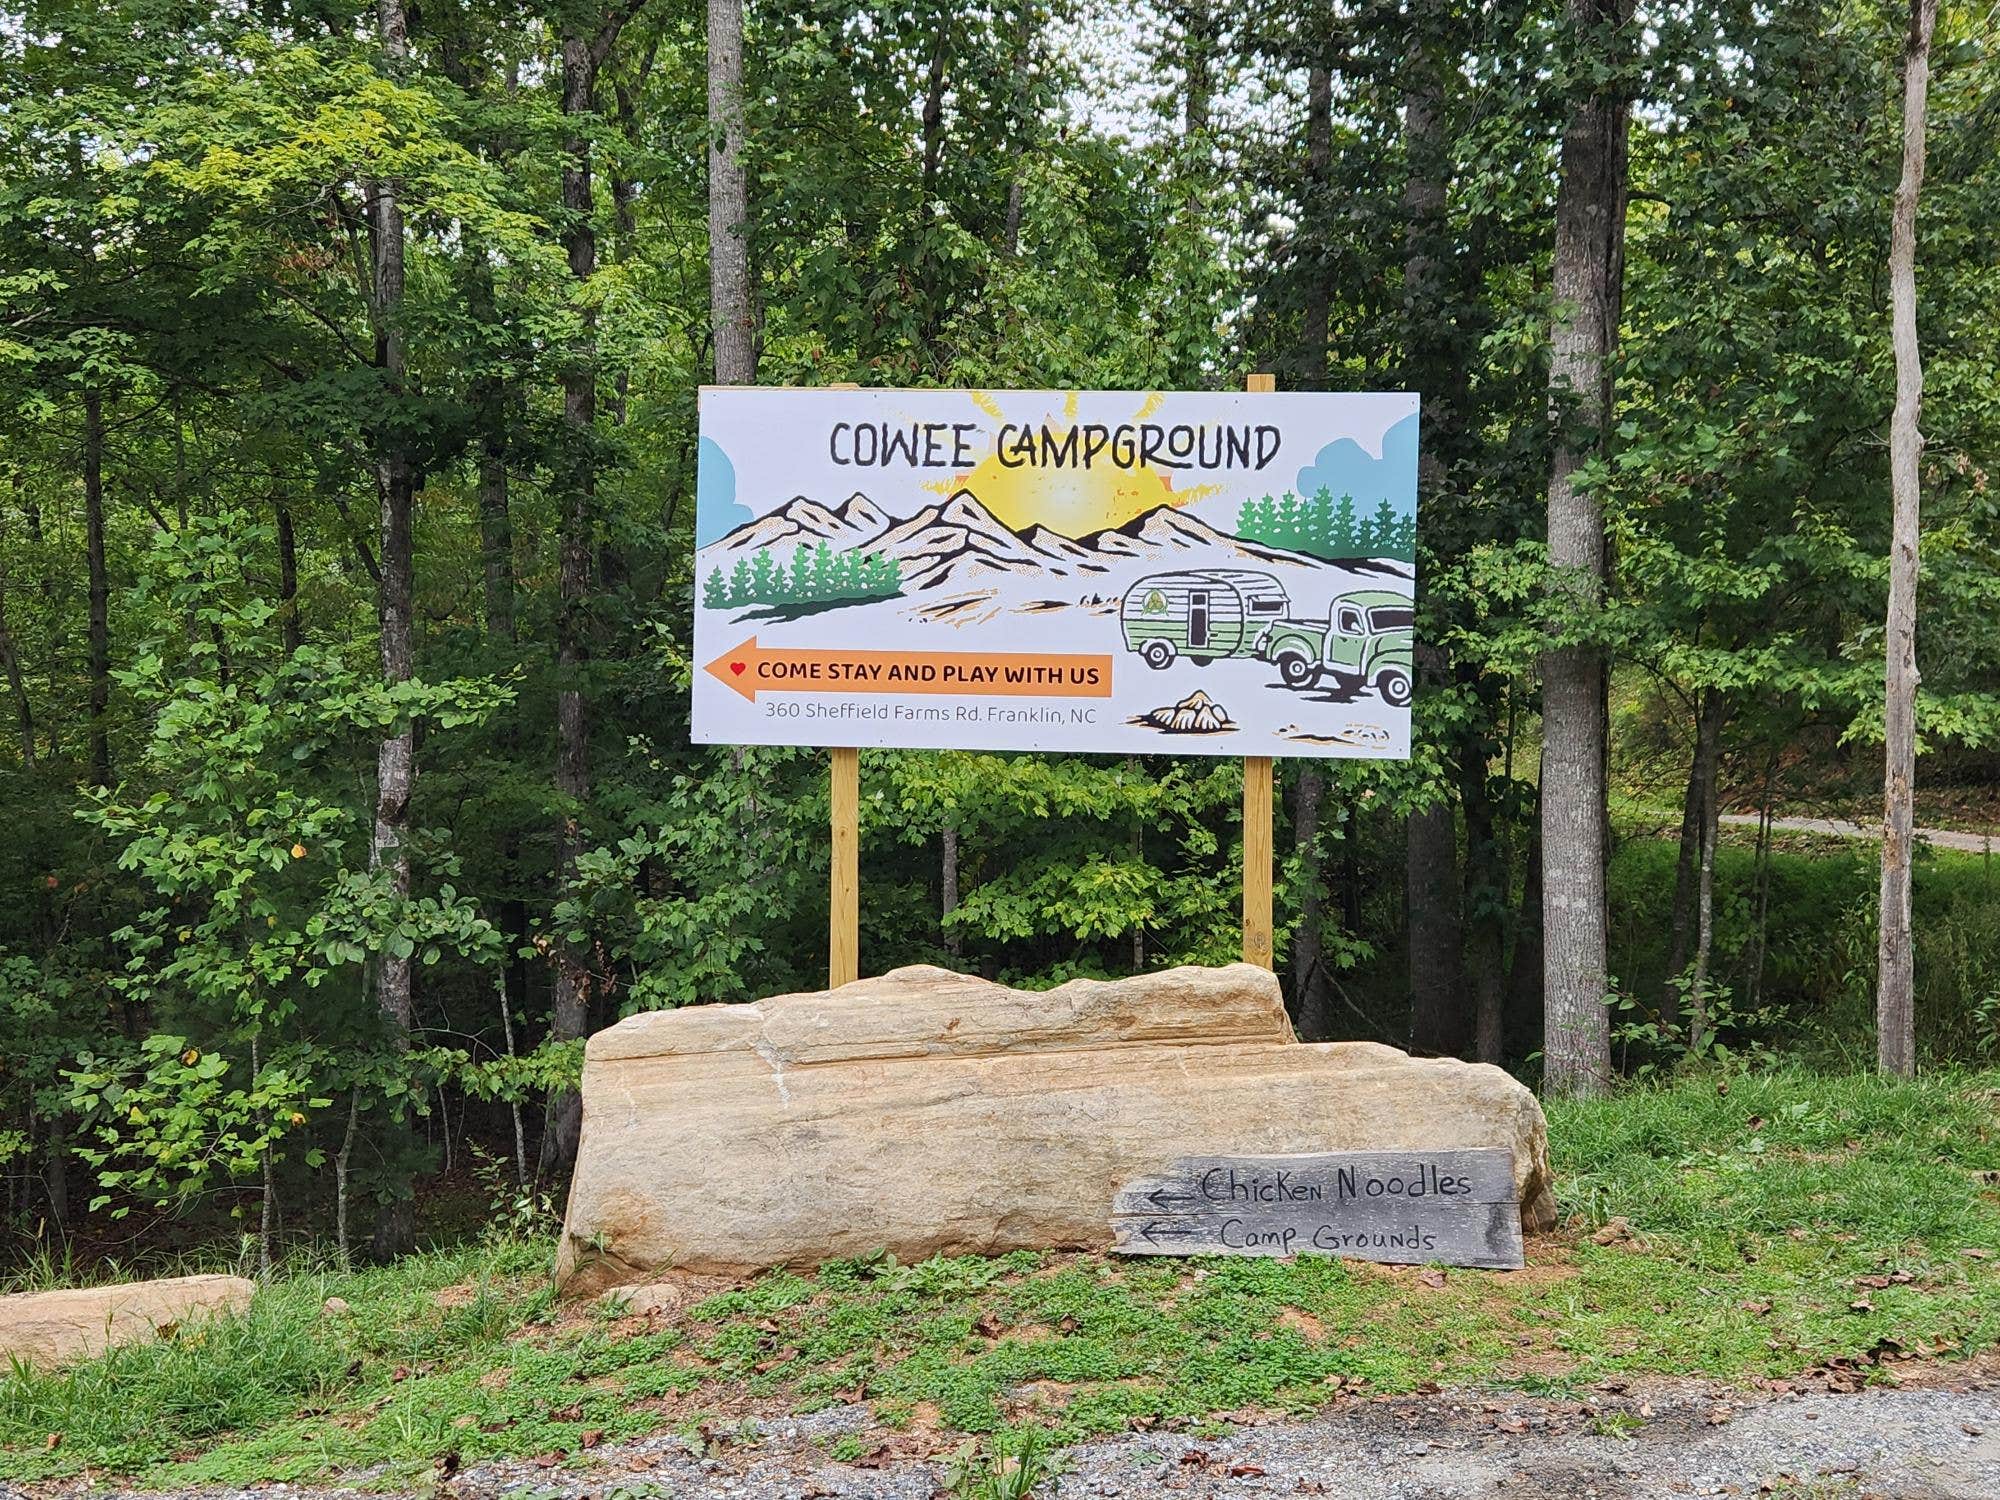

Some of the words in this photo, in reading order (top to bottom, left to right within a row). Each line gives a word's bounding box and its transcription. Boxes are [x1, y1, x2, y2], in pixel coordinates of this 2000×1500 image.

[830, 422, 977, 467] COWEE
[997, 423, 1281, 470] CAMPGROUND
[757, 661, 821, 679] COME
[828, 663, 882, 680] STAY
[888, 664, 936, 681] AND
[943, 666, 998, 682] PLAY
[1004, 667, 1063, 684] WITH
[1070, 668, 1100, 685] US
[766, 702, 800, 718] 360
[806, 703, 888, 720] Sheffield
[895, 706, 950, 721] Farms
[956, 707, 982, 721] Rd.
[988, 707, 1066, 725] Franklin,
[1071, 709, 1097, 723] NC
[1337, 1163, 1472, 1198] Noodles
[1220, 1219, 1296, 1253] Camp
